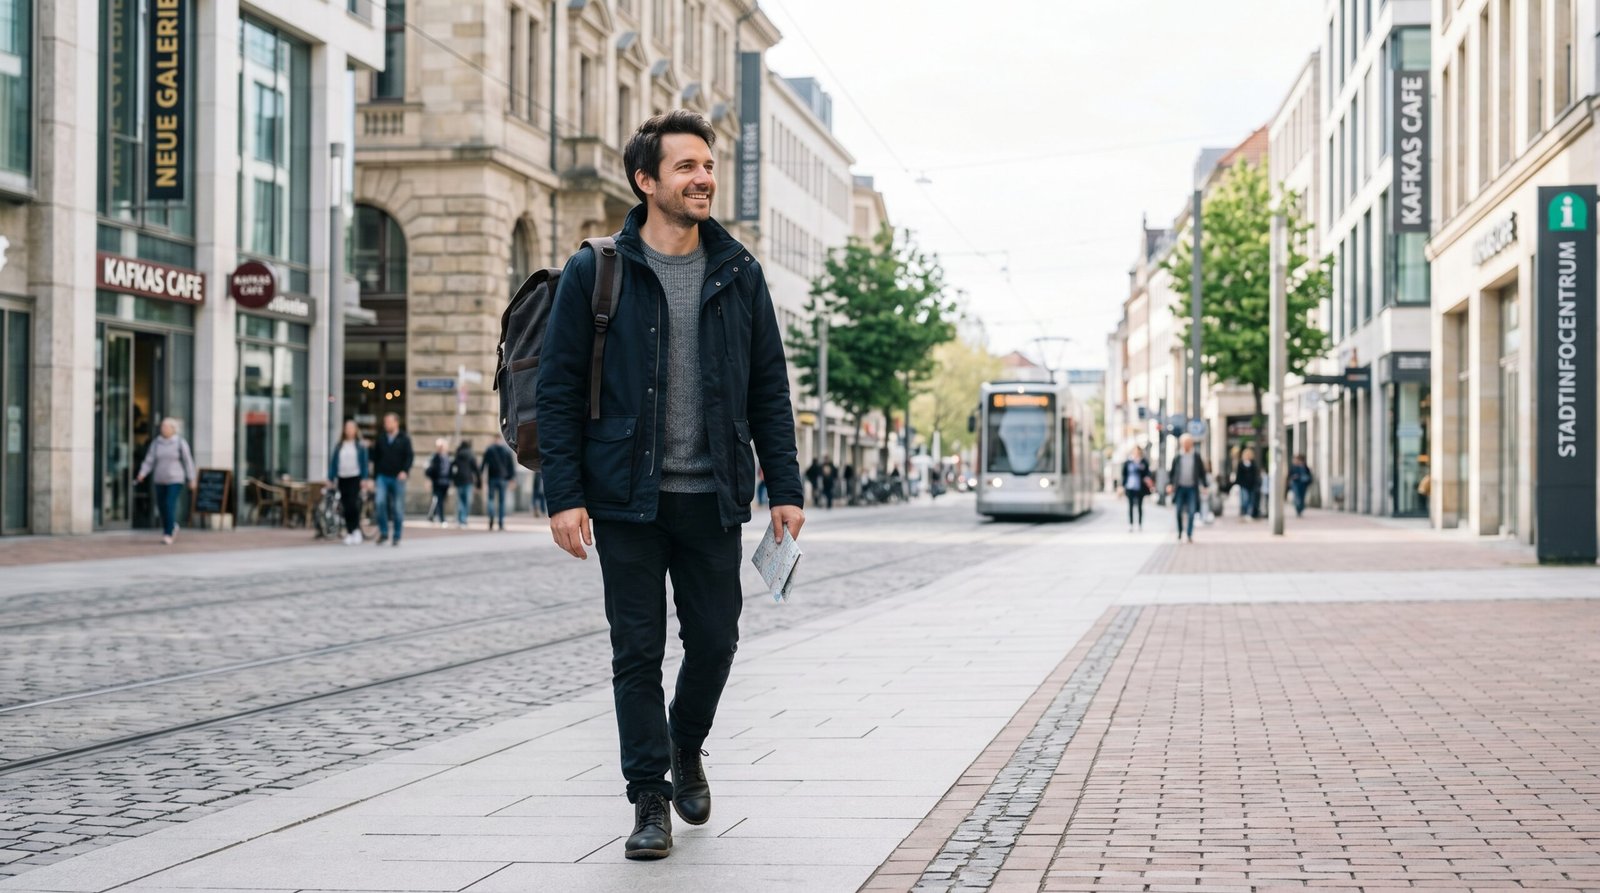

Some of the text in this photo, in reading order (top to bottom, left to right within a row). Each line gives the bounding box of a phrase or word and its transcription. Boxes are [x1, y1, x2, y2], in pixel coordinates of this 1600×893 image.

[156, 115, 177, 187] NEUE
[1401, 76, 1423, 225] KAFKAS CAFE
[104, 257, 165, 294] KAFKAS
[1557, 240, 1577, 458] STADTINFOCENTRUM
